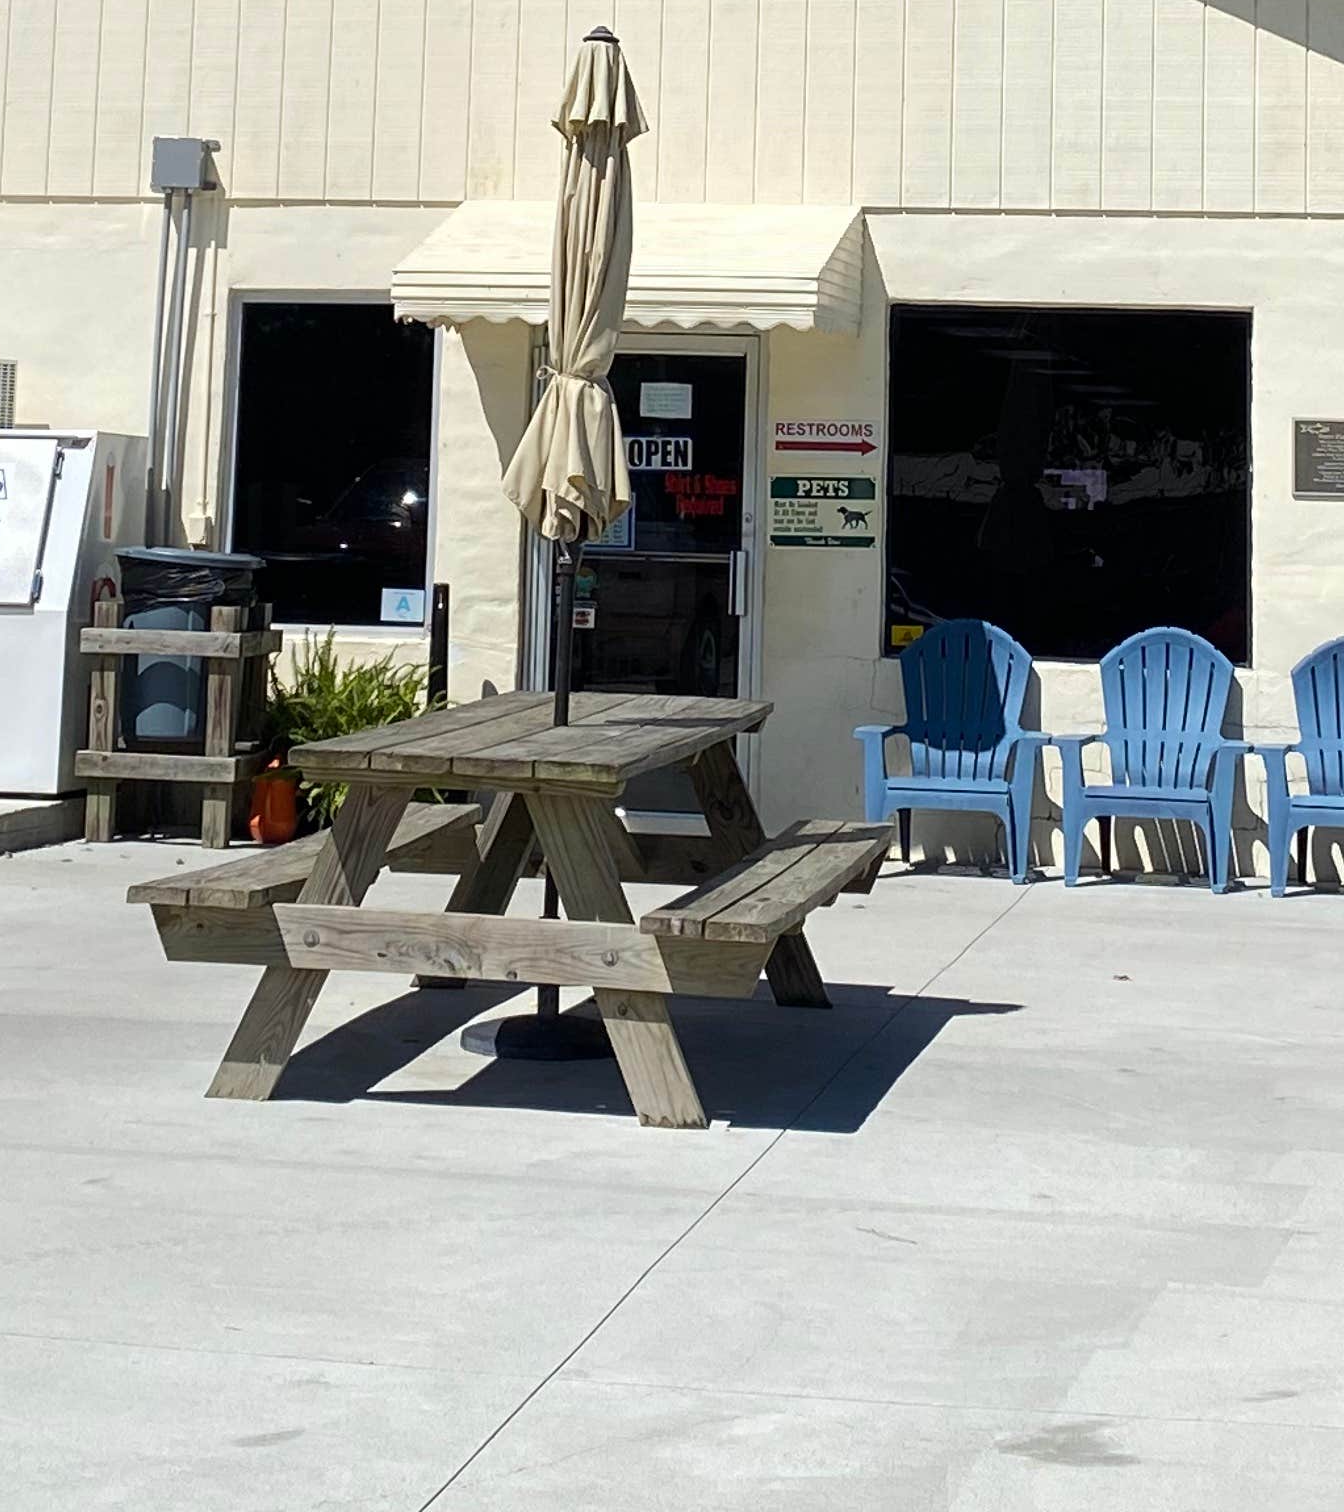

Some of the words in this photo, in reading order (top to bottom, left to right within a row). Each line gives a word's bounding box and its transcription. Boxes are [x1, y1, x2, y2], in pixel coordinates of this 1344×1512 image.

[775, 422, 874, 437] RESTROOMS
[628, 438, 689, 468] OPEN
[796, 479, 849, 497] PETS
[395, 595, 411, 612] A
